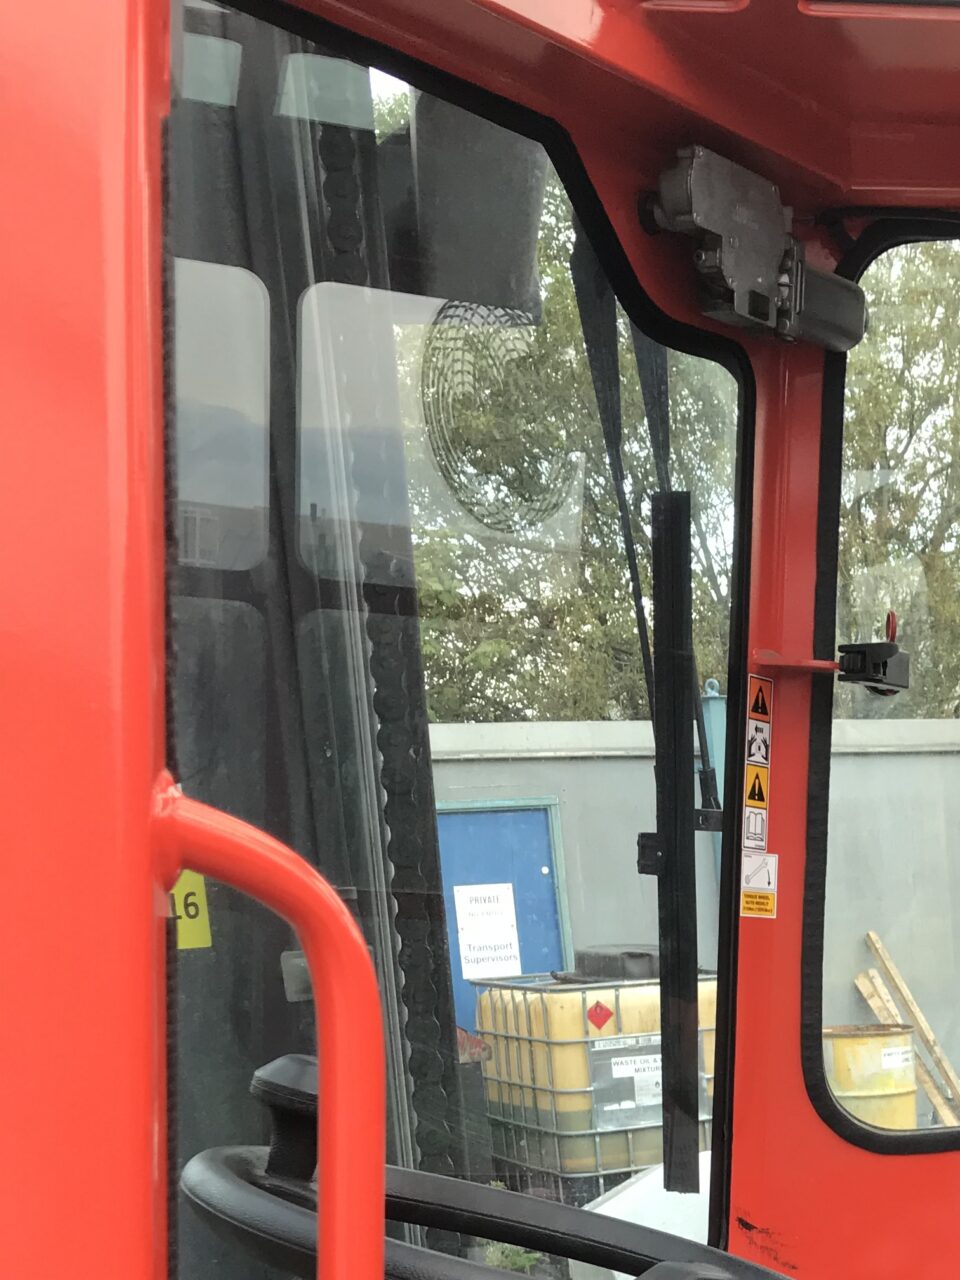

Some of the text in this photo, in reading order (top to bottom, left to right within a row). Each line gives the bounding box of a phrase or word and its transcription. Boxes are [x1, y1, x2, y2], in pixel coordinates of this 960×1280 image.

[467, 942, 513, 953] Transport
[464, 954, 518, 965] Supervisors
[613, 1059, 637, 1067] WASTE
